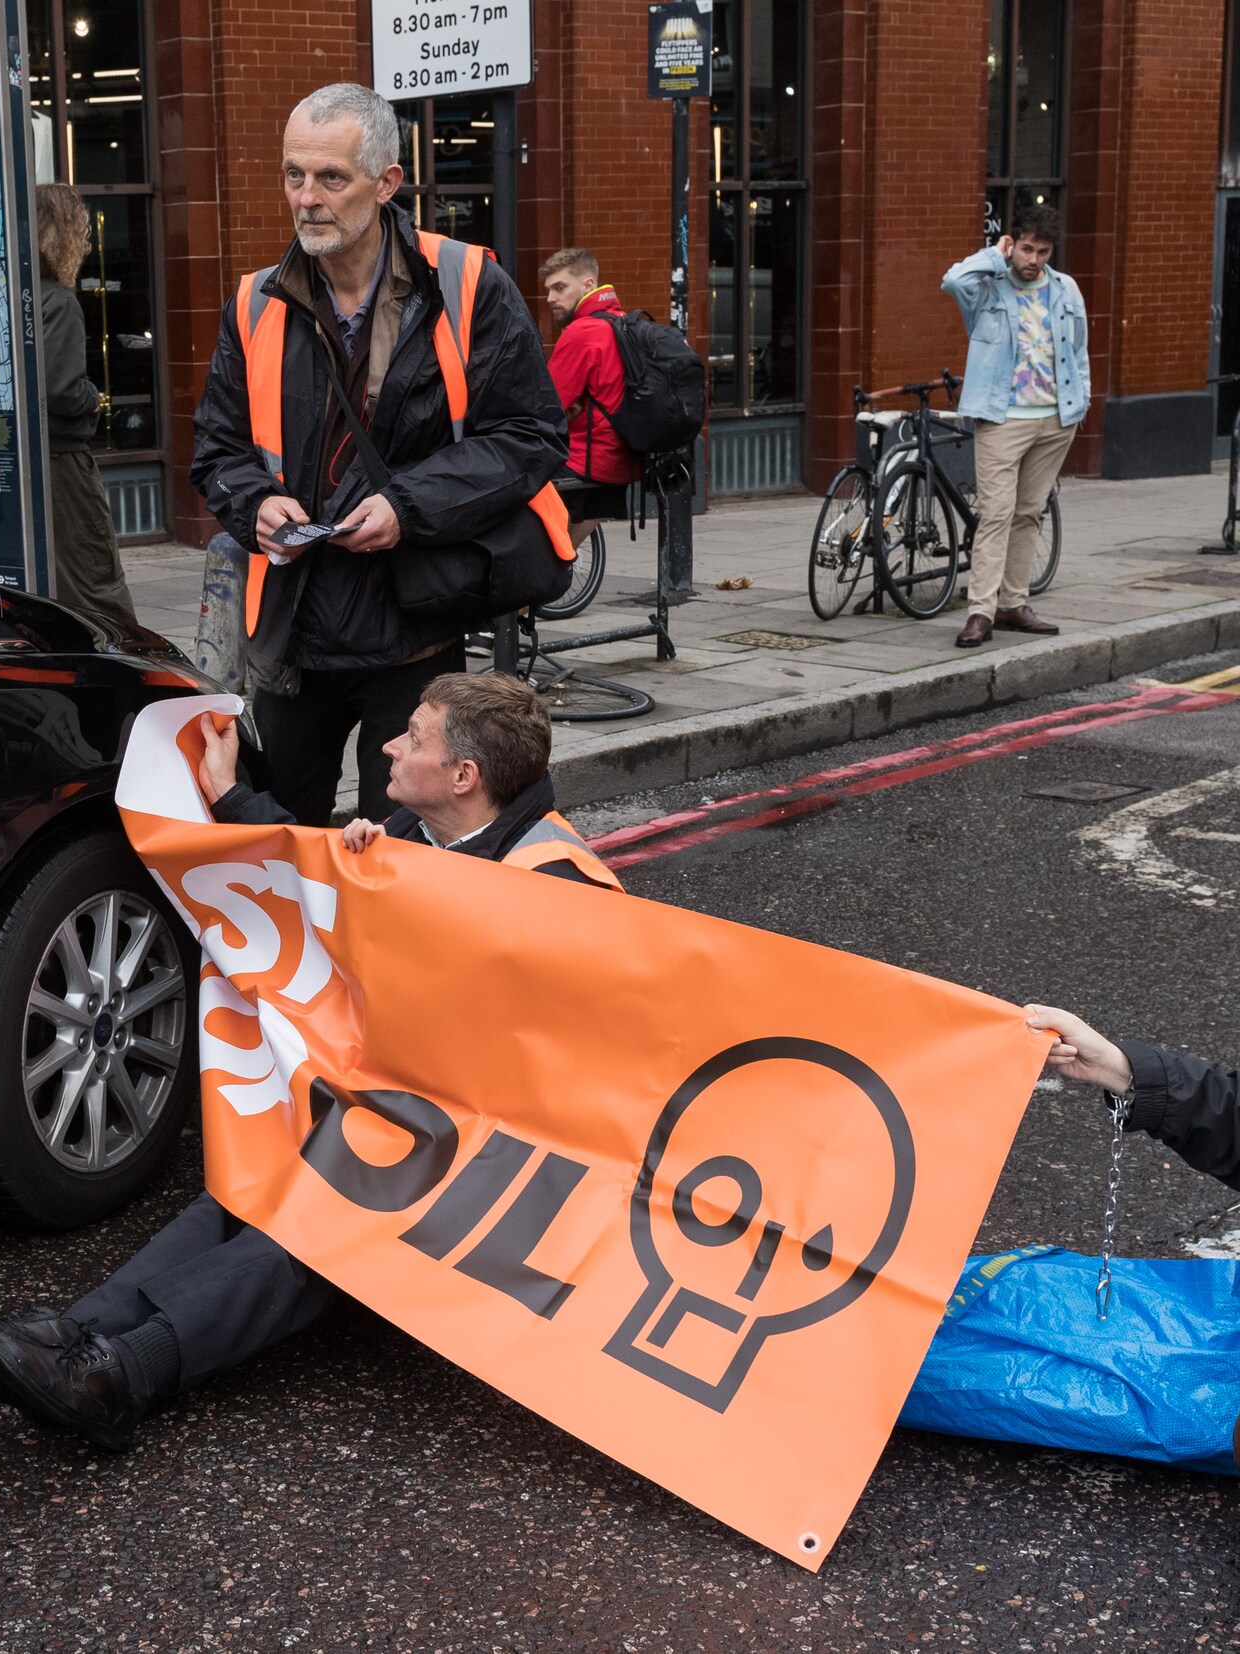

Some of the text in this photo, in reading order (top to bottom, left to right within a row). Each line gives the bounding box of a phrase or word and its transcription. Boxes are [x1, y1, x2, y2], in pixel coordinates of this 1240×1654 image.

[393, 13, 430, 34] 8.30
[434, 12, 457, 28] am
[470, 5, 480, 23] 7
[483, 5, 508, 25] pm
[420, 38, 480, 60] Sunday
[393, 68, 430, 90] 8.30
[434, 68, 457, 84] am
[470, 62, 480, 80] 2
[485, 62, 509, 81] pm
[299, 1075, 591, 1321] OIL
